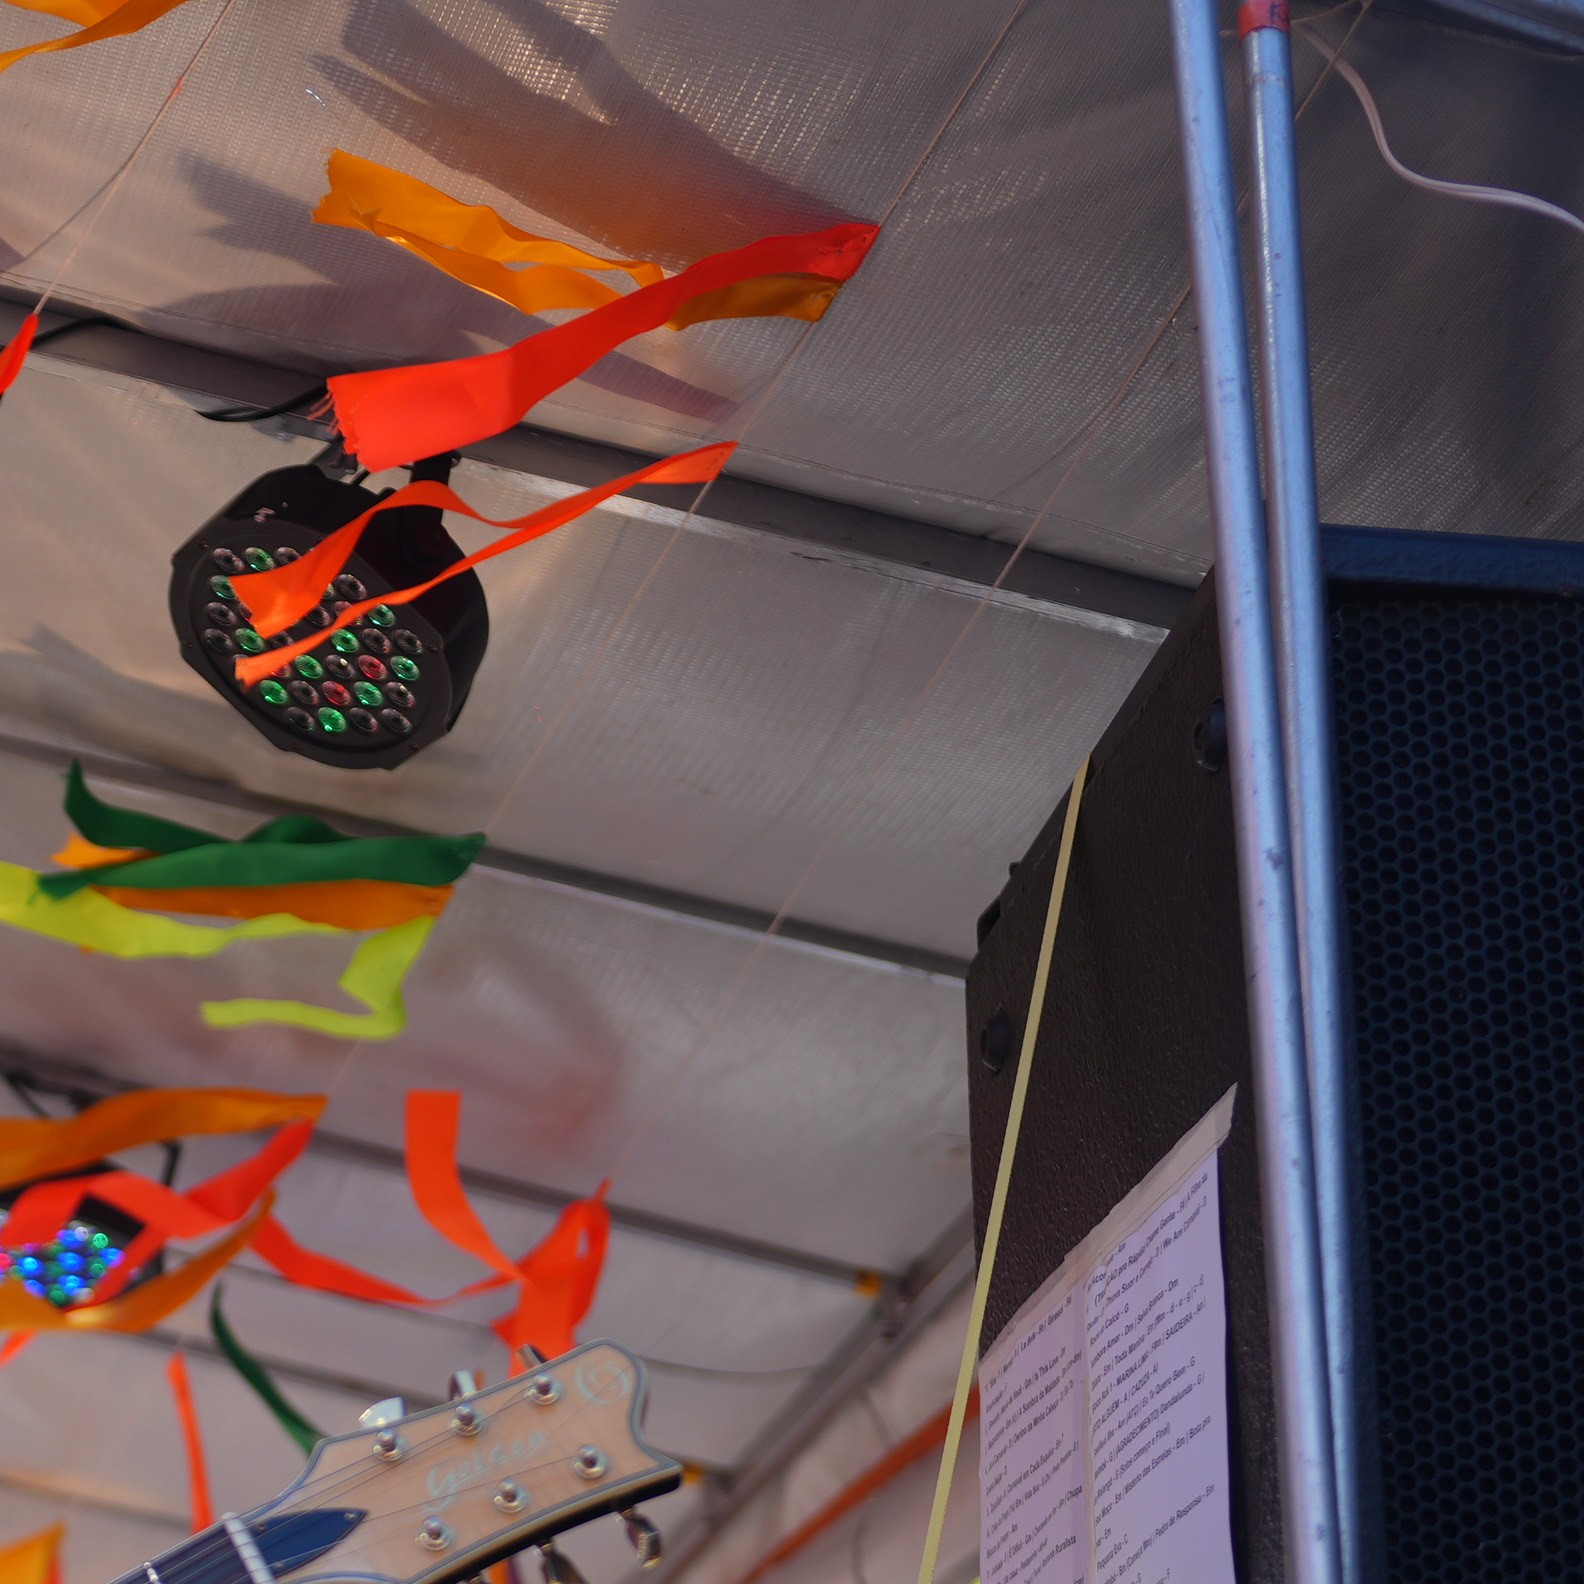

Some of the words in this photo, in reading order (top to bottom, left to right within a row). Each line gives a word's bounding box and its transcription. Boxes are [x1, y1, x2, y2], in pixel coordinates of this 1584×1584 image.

[1159, 1212, 1175, 1229] Gente
[1107, 1334, 1120, 1348] Amar
[1116, 1363, 1137, 1385] MARINA
[1165, 1312, 1192, 1339] SAIDEIRA
[1039, 1365, 1048, 1375] This
[1131, 1372, 1149, 1395] CAZUZA
[1155, 1377, 1171, 1394] Quero
[1023, 1396, 1038, 1413] Sombra
[1160, 1384, 1193, 1413] Dandalunda
[1133, 1441, 1151, 1461] começo
[1151, 1448, 1171, 1469] Estrelas
[423, 1432, 545, 1513] Golden
[1067, 1485, 1082, 1500] Chupa
[1055, 1536, 1076, 1553] Ruralista
